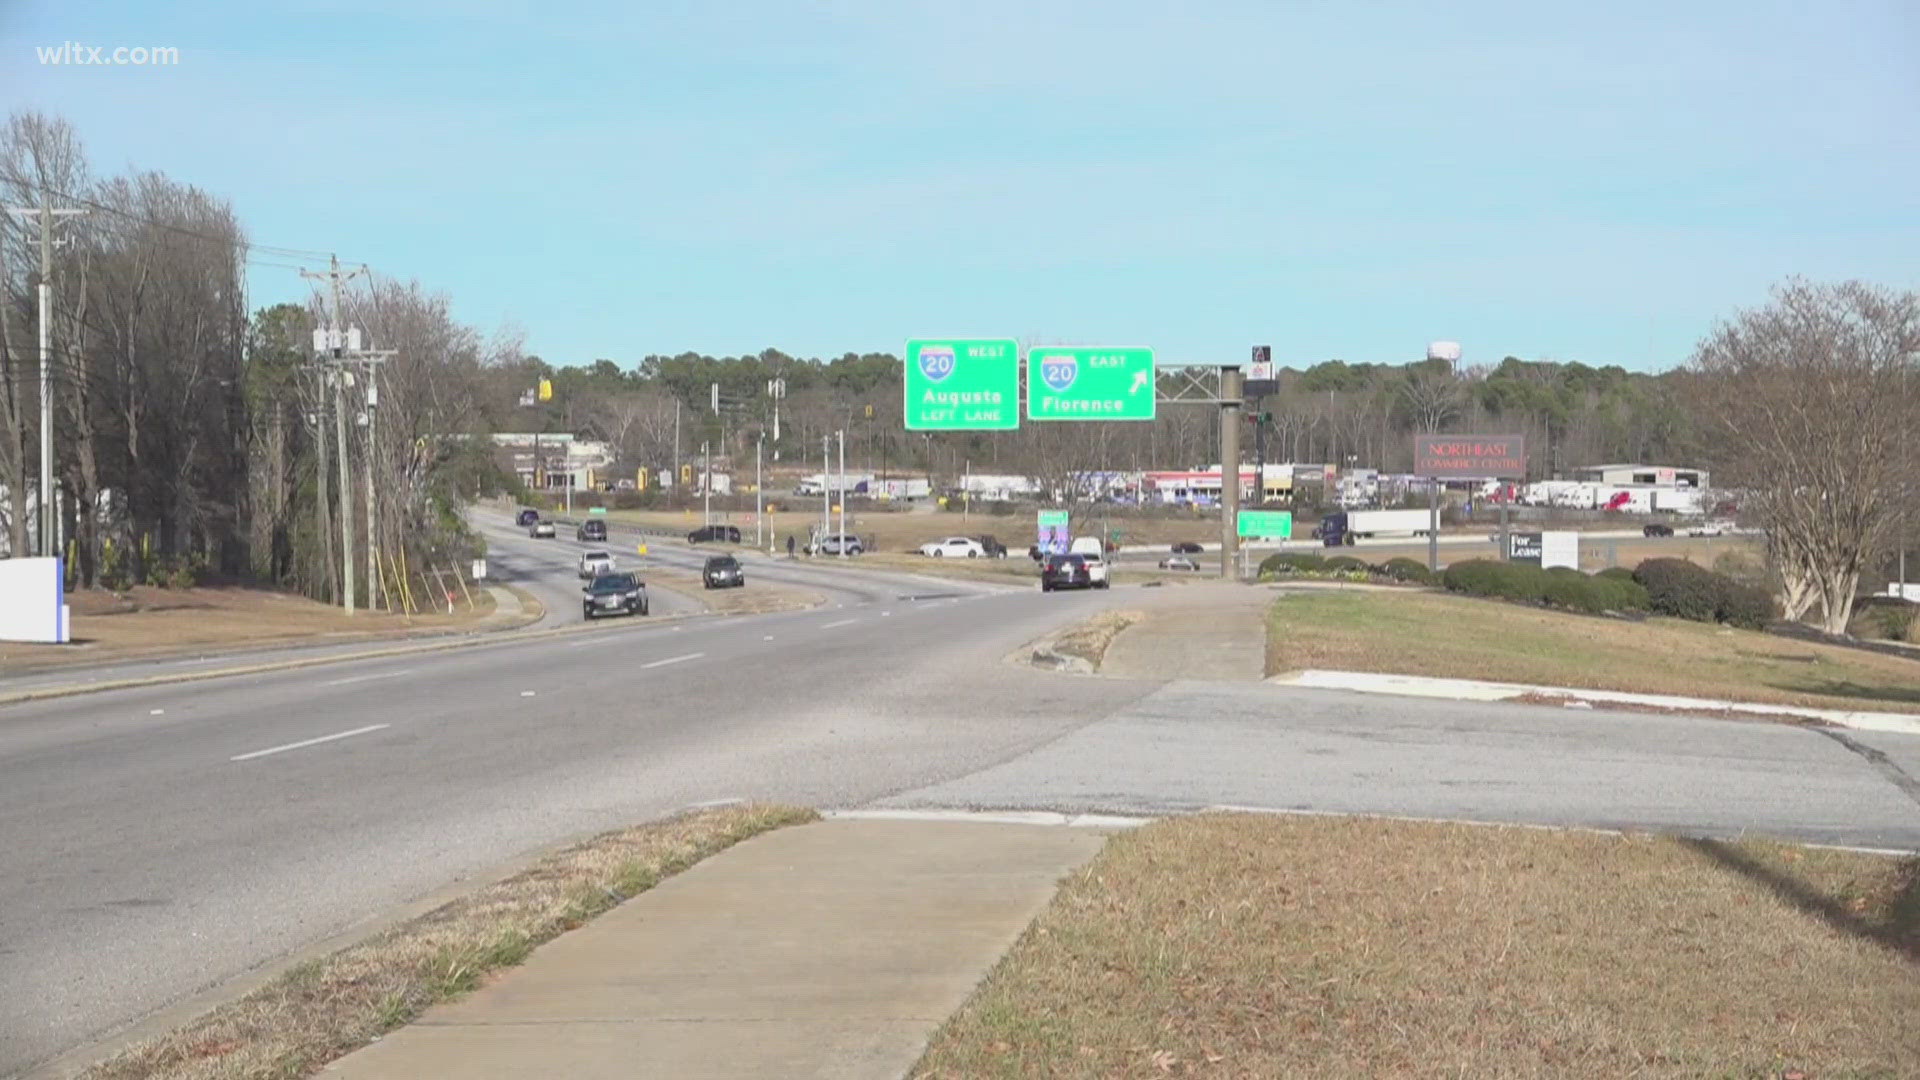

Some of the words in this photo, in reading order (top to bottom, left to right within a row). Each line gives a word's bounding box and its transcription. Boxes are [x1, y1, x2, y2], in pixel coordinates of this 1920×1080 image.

[968, 345, 1005, 357] WEST
[926, 355, 950, 373] 20
[1090, 356, 1126, 368] EAST
[1048, 366, 1072, 382] 20
[924, 389, 1002, 407] Augusta
[1043, 397, 1123, 412] Florence
[922, 410, 954, 421] LEFT
[965, 410, 1001, 421] LANE
[1429, 443, 1507, 456] NORTHEAST
[1421, 459, 1477, 469] COMMERCE
[1481, 459, 1519, 469] CENTER
[1511, 534, 1530, 546] For
[1511, 545, 1541, 557] Lease
